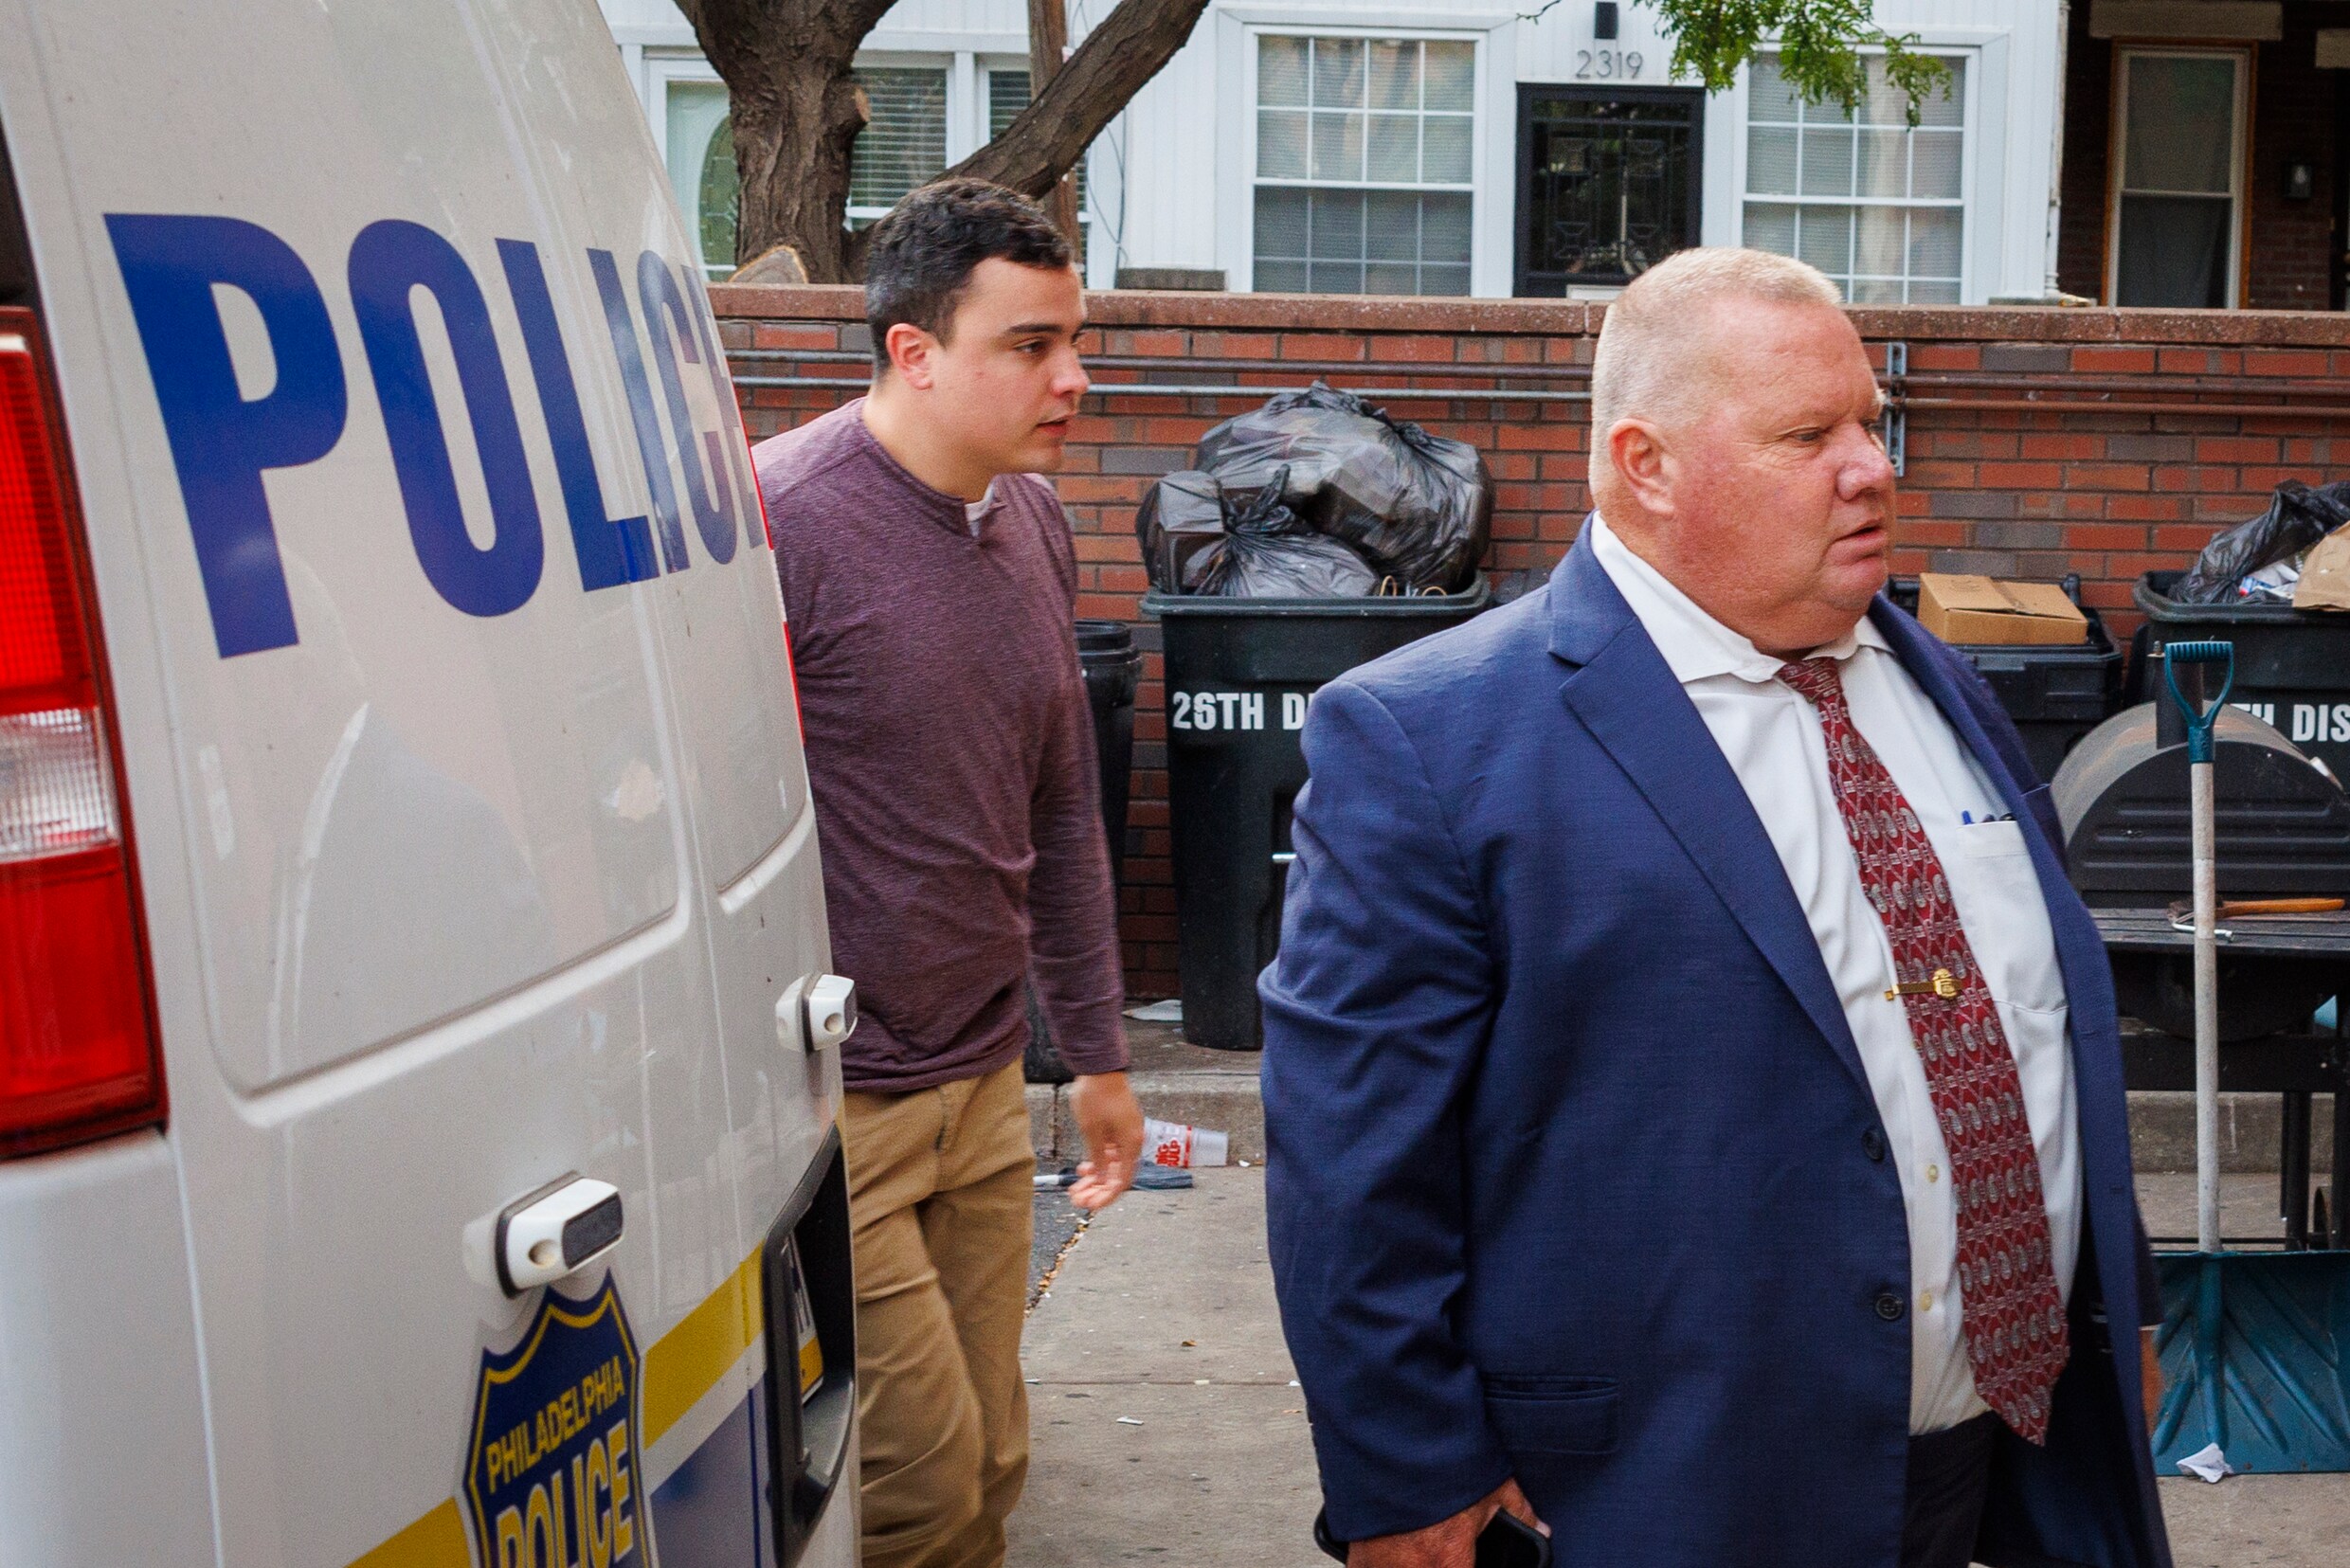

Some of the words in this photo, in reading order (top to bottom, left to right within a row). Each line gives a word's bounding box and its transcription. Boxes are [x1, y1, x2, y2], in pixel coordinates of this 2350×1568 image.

[1575, 49, 1644, 79] 2319
[1172, 692, 1264, 730] 26TH
[1282, 693, 1318, 730] D
[485, 1355, 625, 1495] PHILADELPHIA
